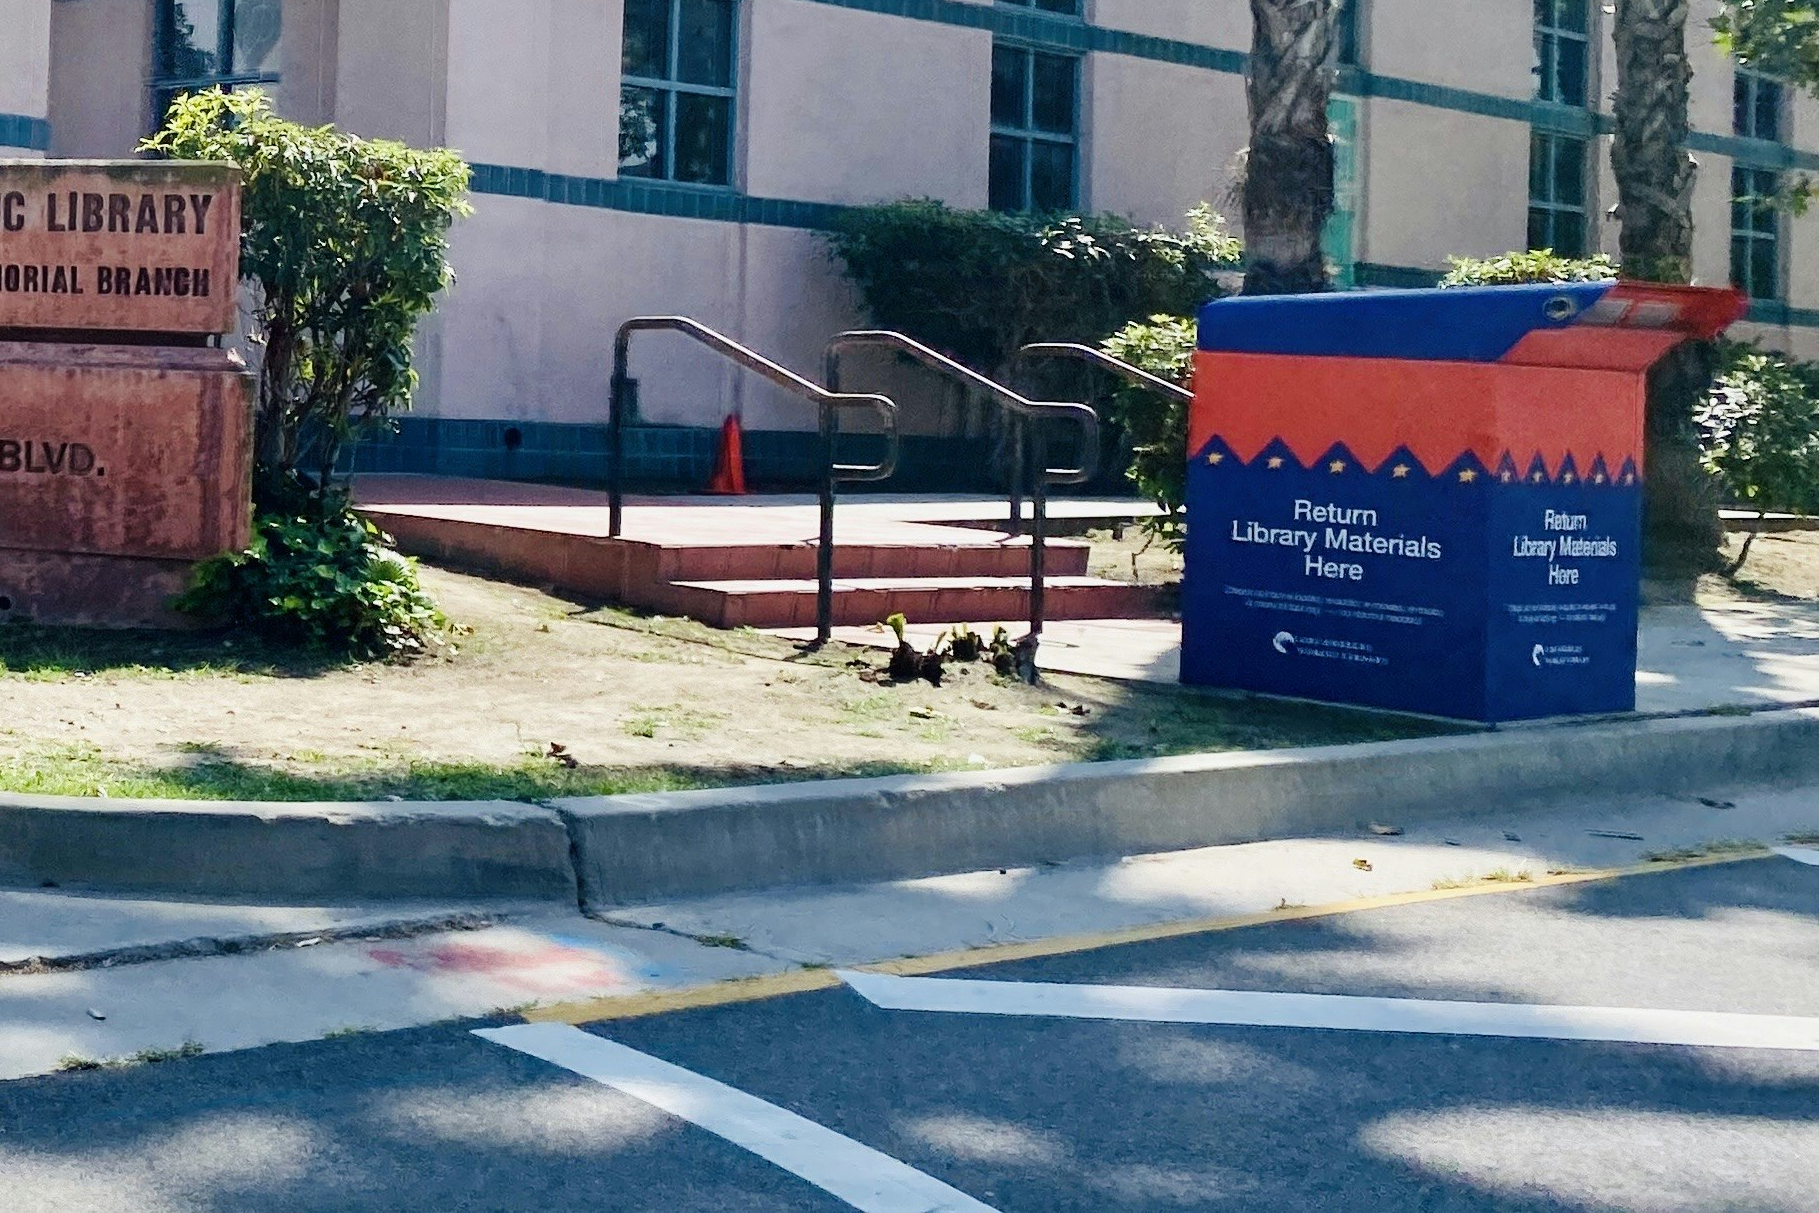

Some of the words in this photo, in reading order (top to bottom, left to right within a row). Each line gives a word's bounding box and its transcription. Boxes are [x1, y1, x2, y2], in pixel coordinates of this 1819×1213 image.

[47, 191, 213, 234] LIBRARY
[97, 265, 210, 297] BRANCH
[1293, 499, 1378, 527] Return
[1544, 508, 1587, 531] Return
[1231, 519, 1318, 553] Library
[1324, 527, 1442, 559] Materials
[1513, 535, 1557, 563] Library
[1559, 535, 1618, 557] Materials
[1304, 554, 1364, 581] Here
[1548, 563, 1580, 586] Here
